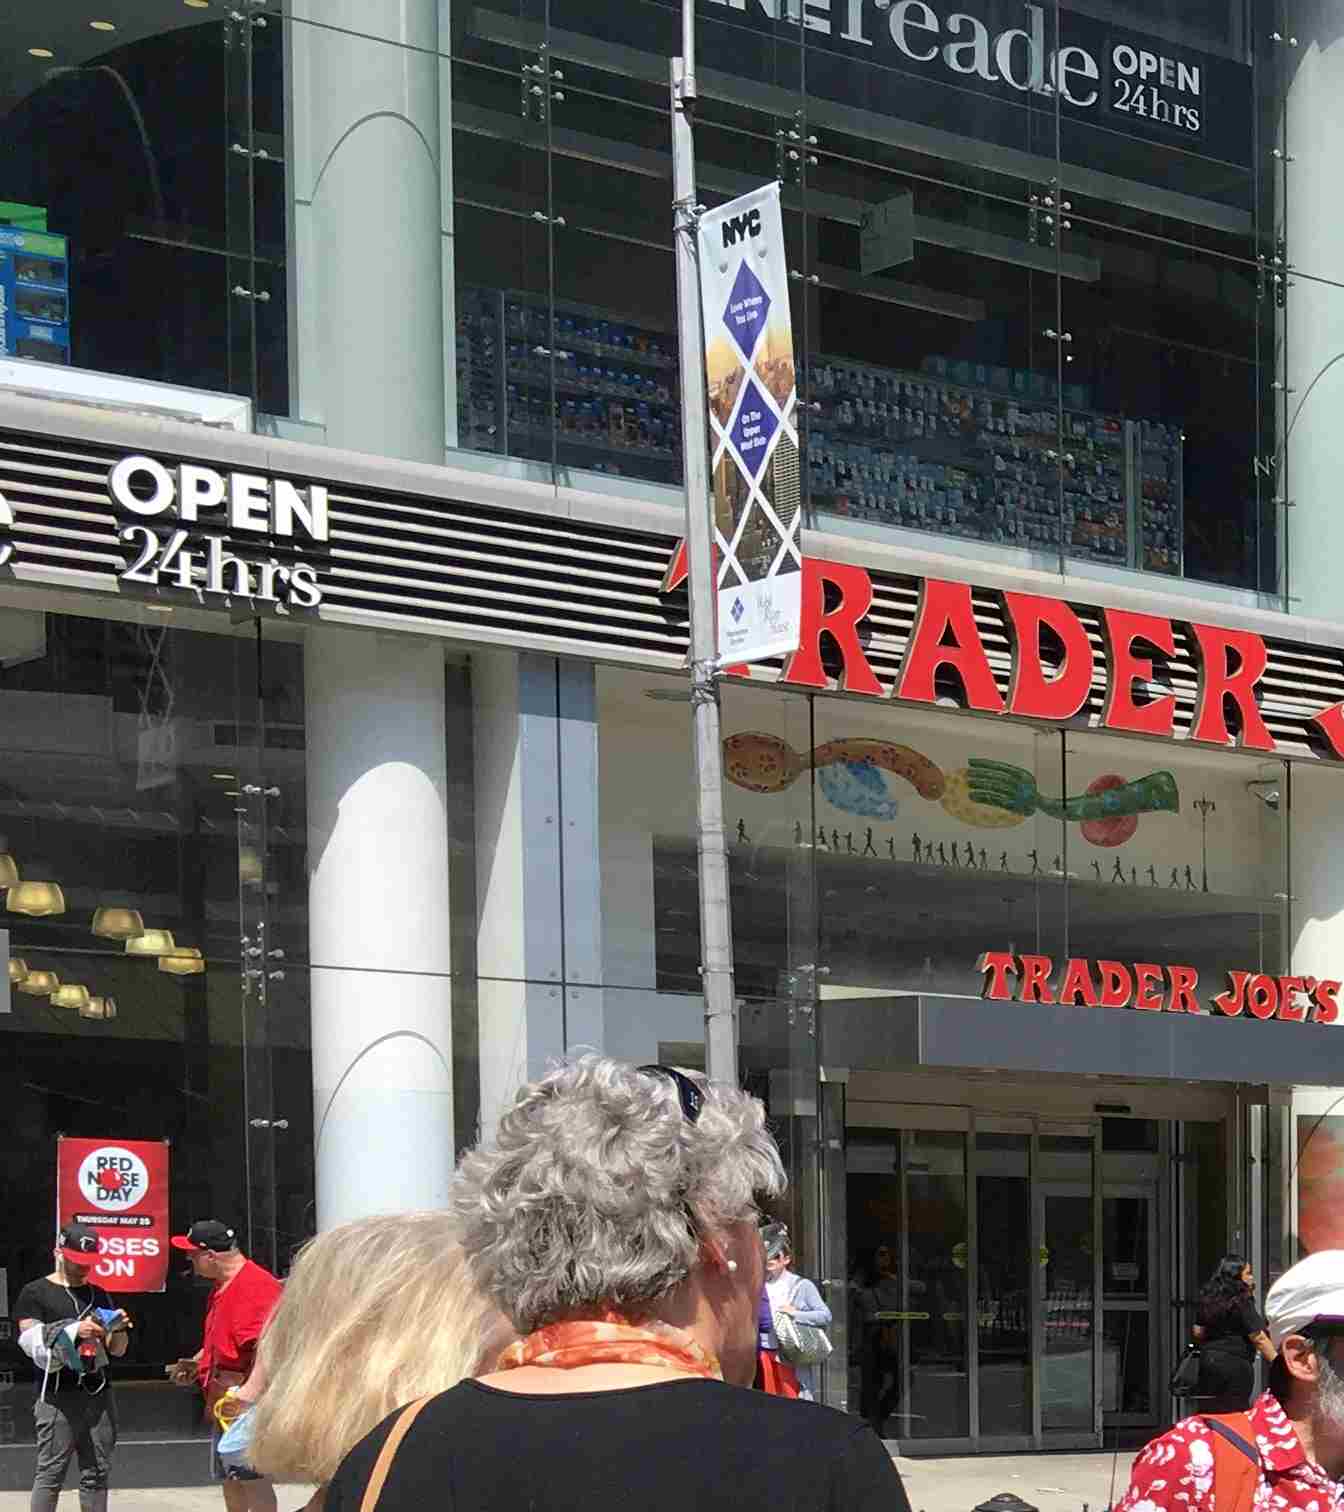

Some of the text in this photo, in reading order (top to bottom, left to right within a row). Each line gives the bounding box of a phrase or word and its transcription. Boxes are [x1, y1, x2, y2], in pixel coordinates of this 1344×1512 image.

[1112, 44, 1200, 96] OPEN
[1112, 78, 1201, 132] 24hrs
[721, 208, 762, 249] NYC
[108, 454, 329, 542] OPEN
[119, 525, 322, 608] 24hrs
[660, 538, 1276, 752] RADER
[980, 950, 1344, 1025] TRADER JOE'S
[96, 1156, 133, 1172] RED
[76, 1215, 118, 1224] THURSDAY
[120, 1216, 138, 1225] MAY
[96, 1187, 133, 1202] DAY
[97, 1236, 160, 1257] OSES
